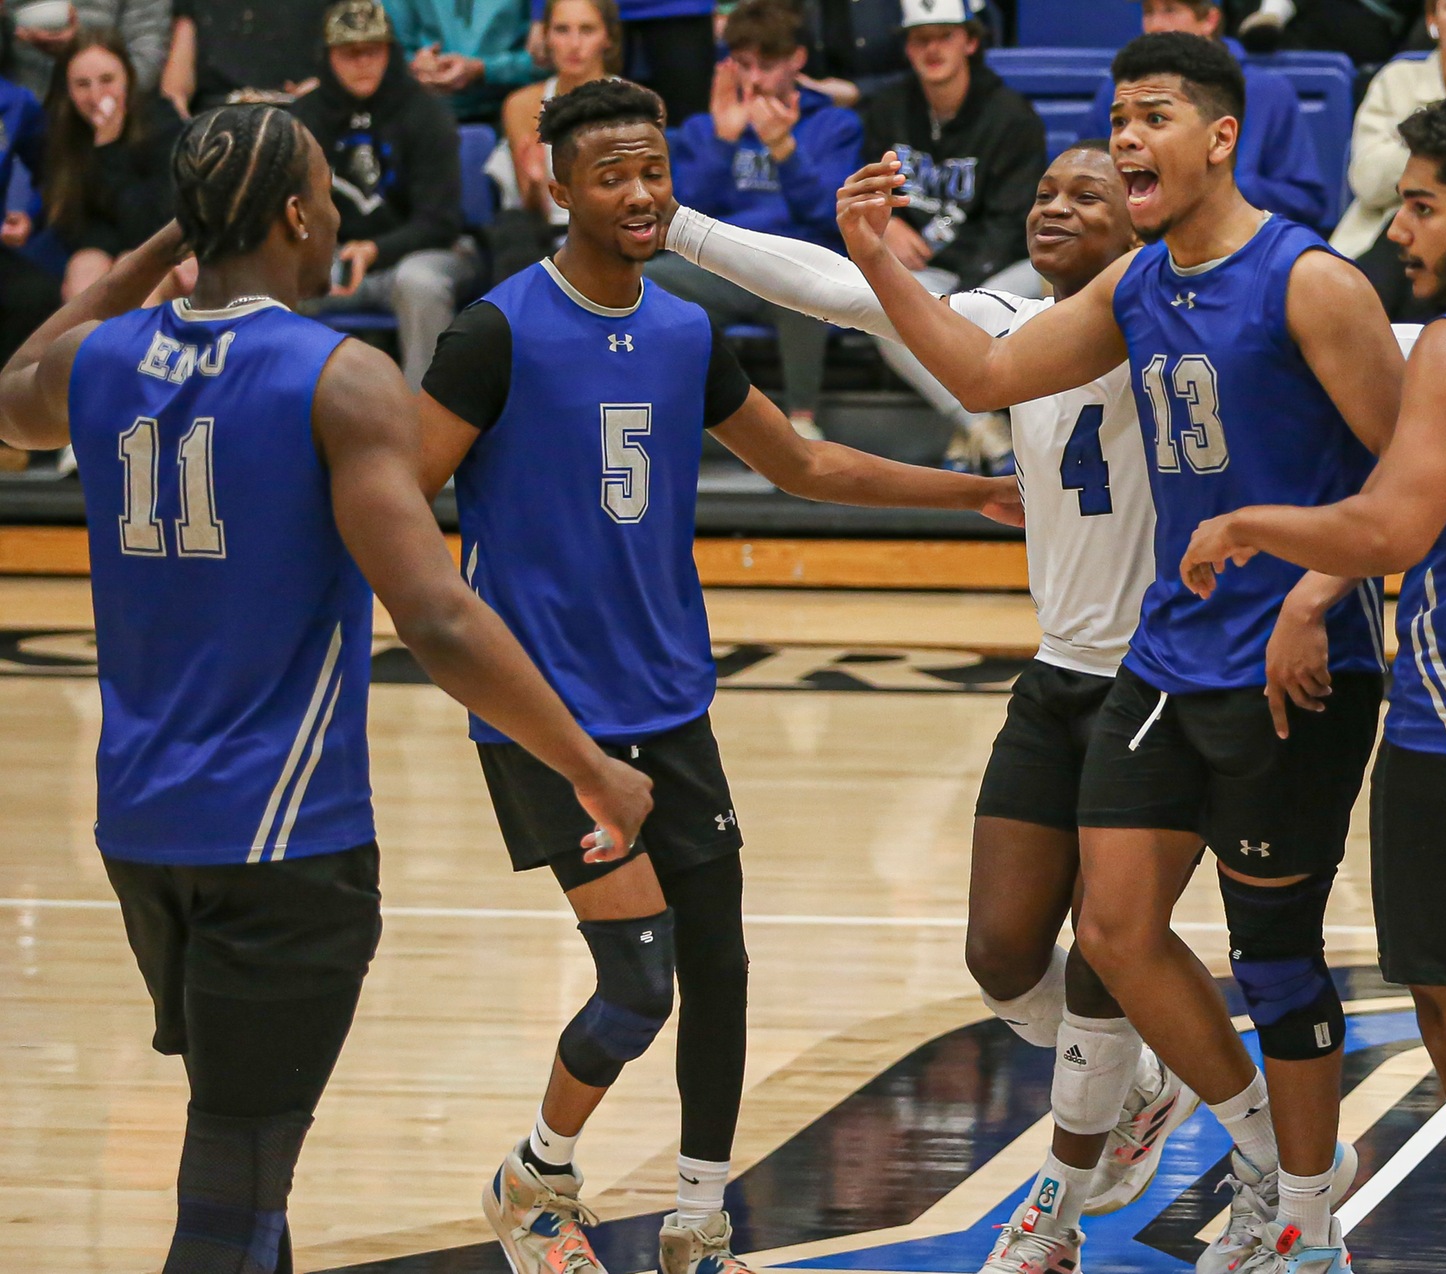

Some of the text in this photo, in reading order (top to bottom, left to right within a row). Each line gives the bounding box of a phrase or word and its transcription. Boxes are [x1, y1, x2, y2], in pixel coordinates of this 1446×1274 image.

[138, 330, 236, 385] EMU
[1143, 354, 1229, 474] 13
[118, 417, 226, 558] 11
[600, 403, 651, 523] 5
[1060, 404, 1113, 517] 4
